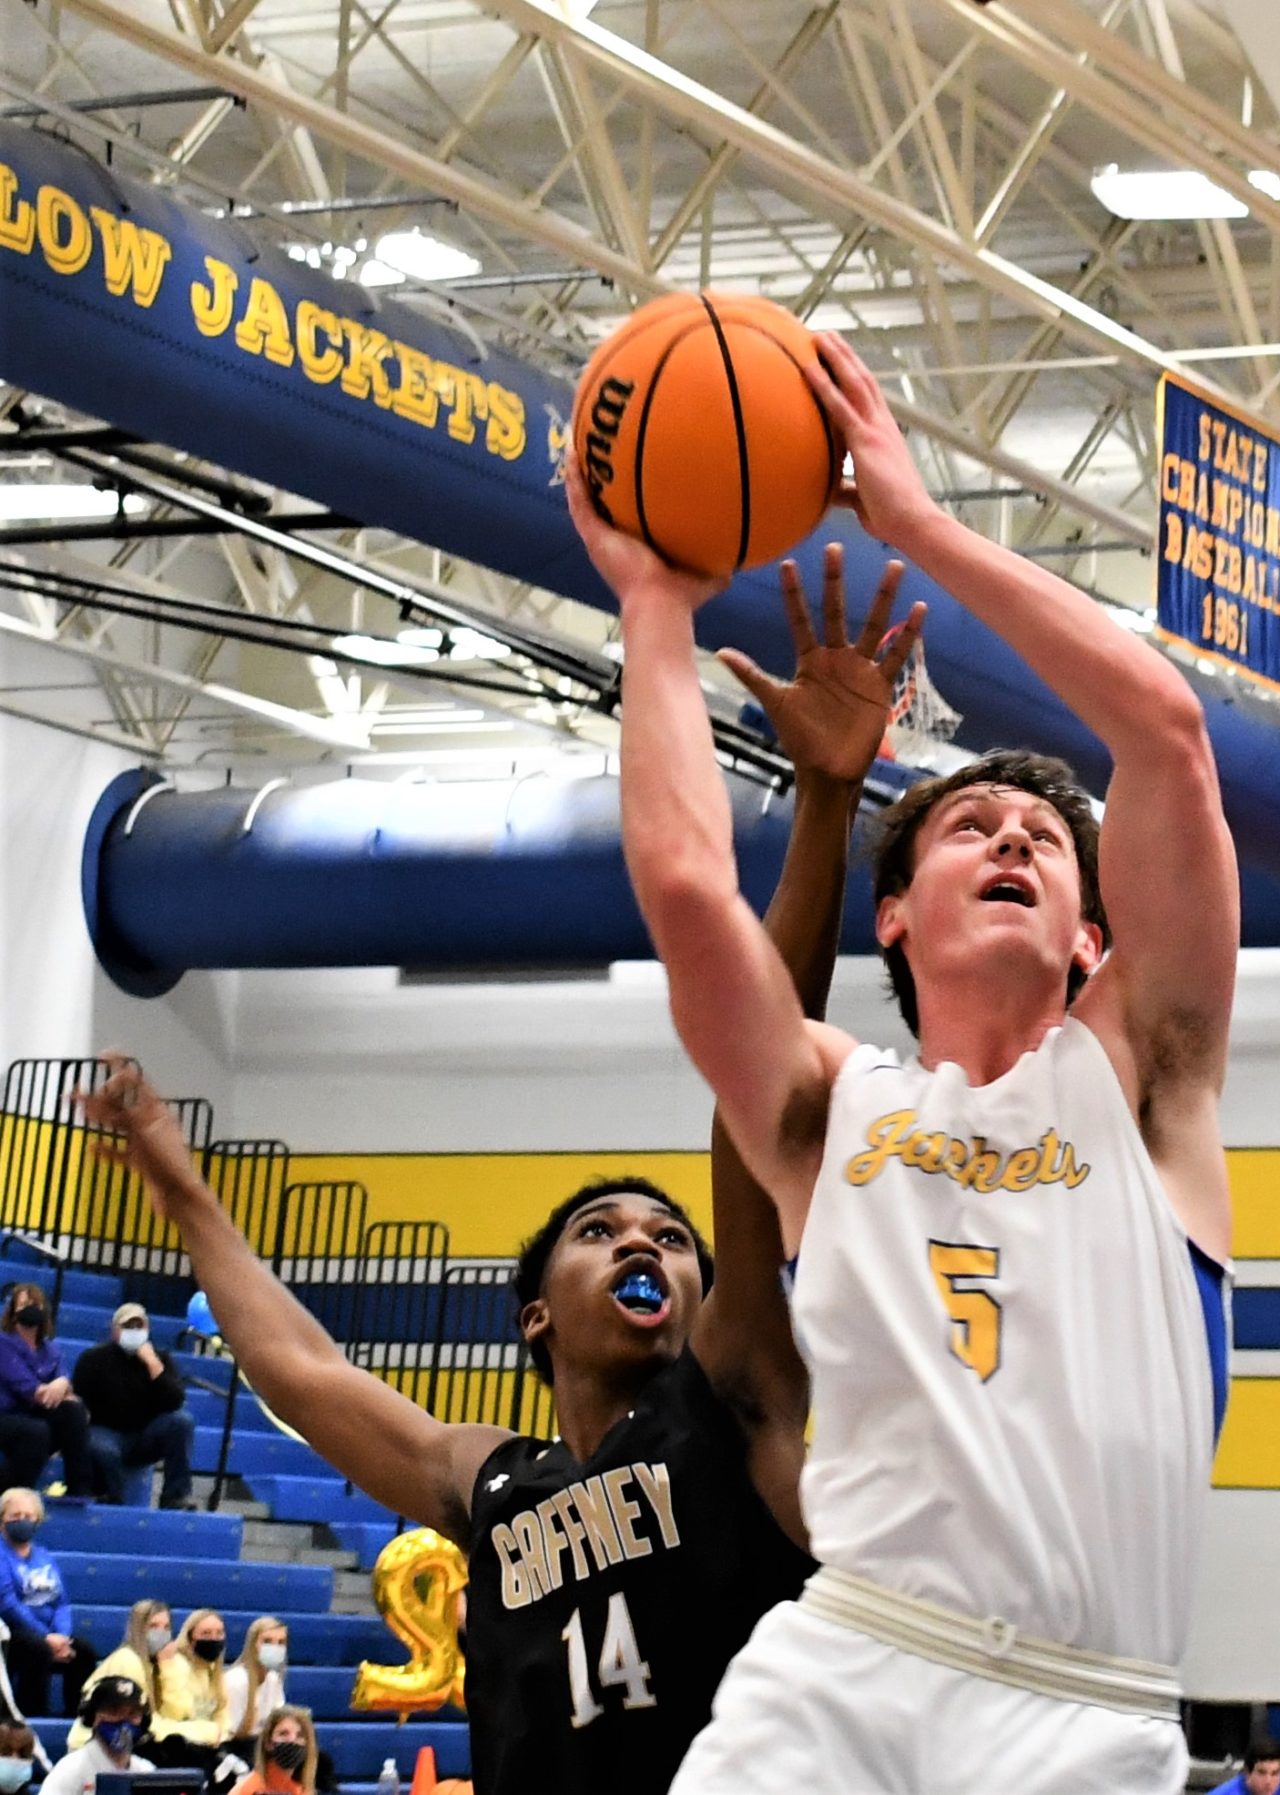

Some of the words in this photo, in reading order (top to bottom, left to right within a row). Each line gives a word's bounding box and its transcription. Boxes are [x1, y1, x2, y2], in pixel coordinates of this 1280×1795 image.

[191, 255, 526, 461] JACKETS
[1199, 411, 1267, 493] STATE
[844, 1108, 1092, 1193] Jackets
[929, 1239, 1001, 1384] 5
[491, 1462, 681, 1610] GAFFNEY
[561, 1591, 657, 1729] 14
